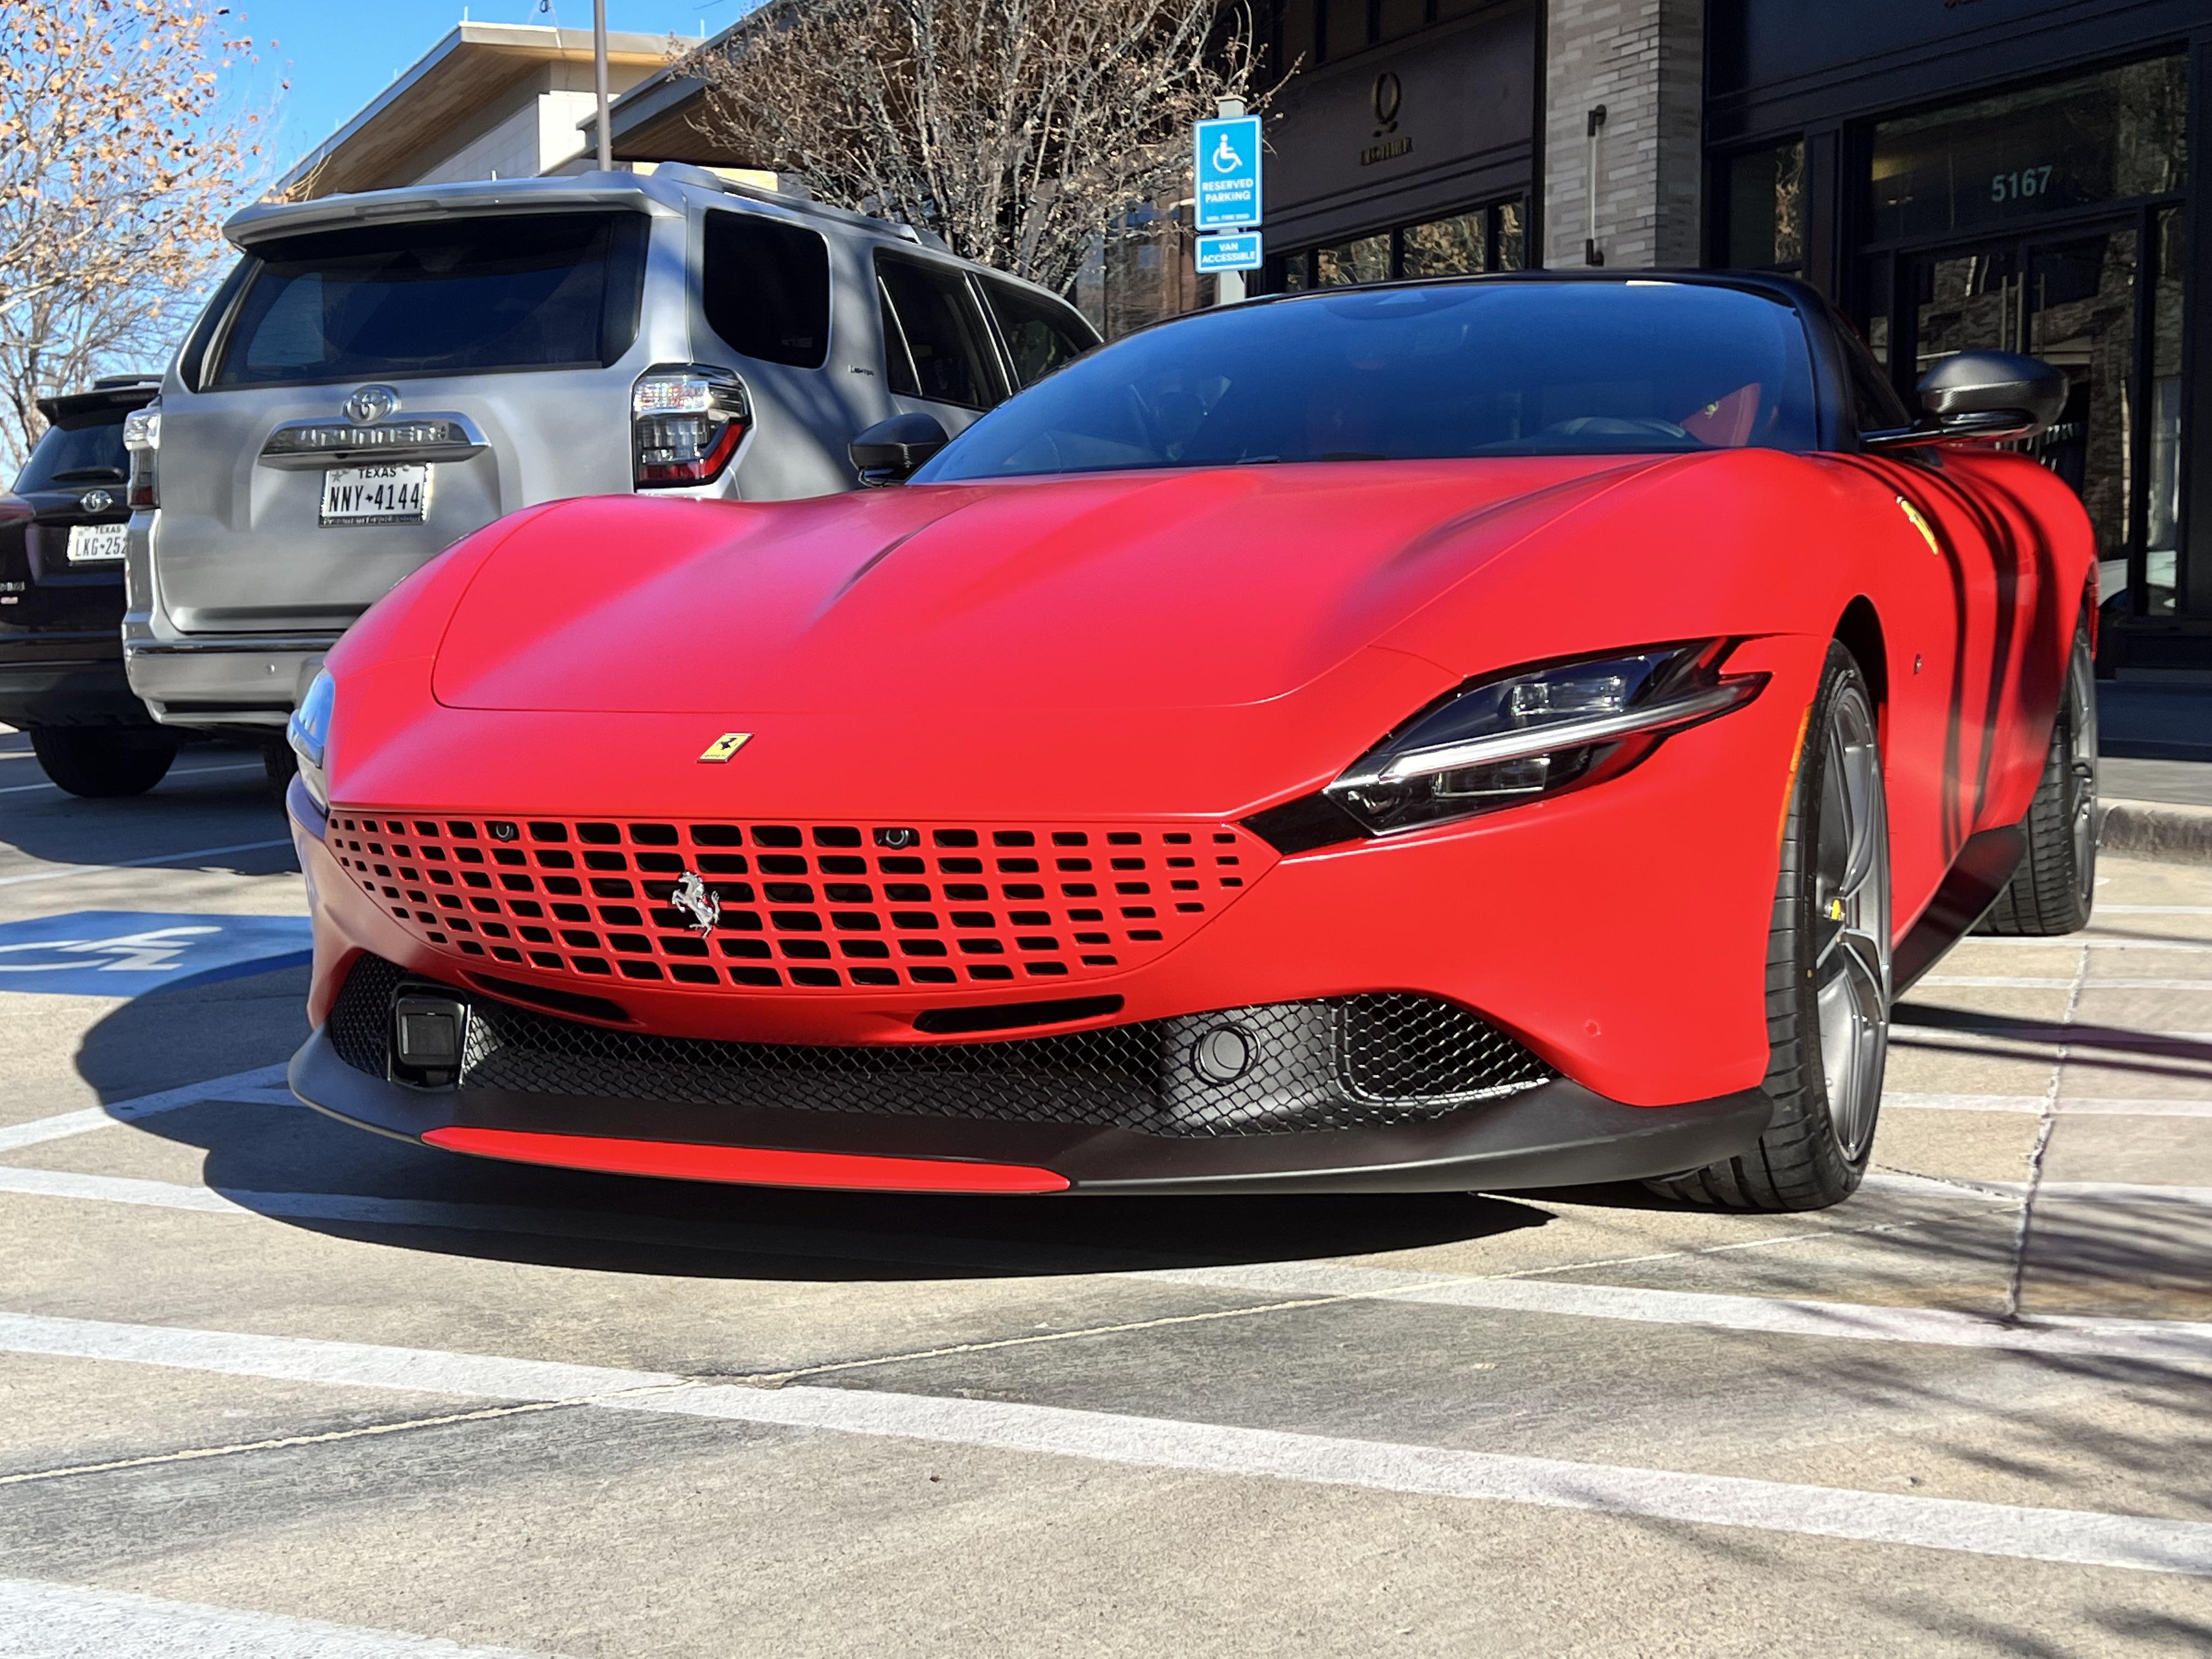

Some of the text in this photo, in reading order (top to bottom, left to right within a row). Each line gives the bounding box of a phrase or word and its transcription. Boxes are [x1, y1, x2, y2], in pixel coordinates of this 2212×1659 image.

[1202, 178, 1254, 191] RESERVED
[1991, 166, 2053, 203] 5167
[1205, 190, 1251, 202] PARKING
[1218, 242, 1238, 251] VAN
[1202, 251, 1255, 263] ACCESSIBLE
[359, 467, 397, 479] TEXAS
[94, 525, 121, 534] TEXAS
